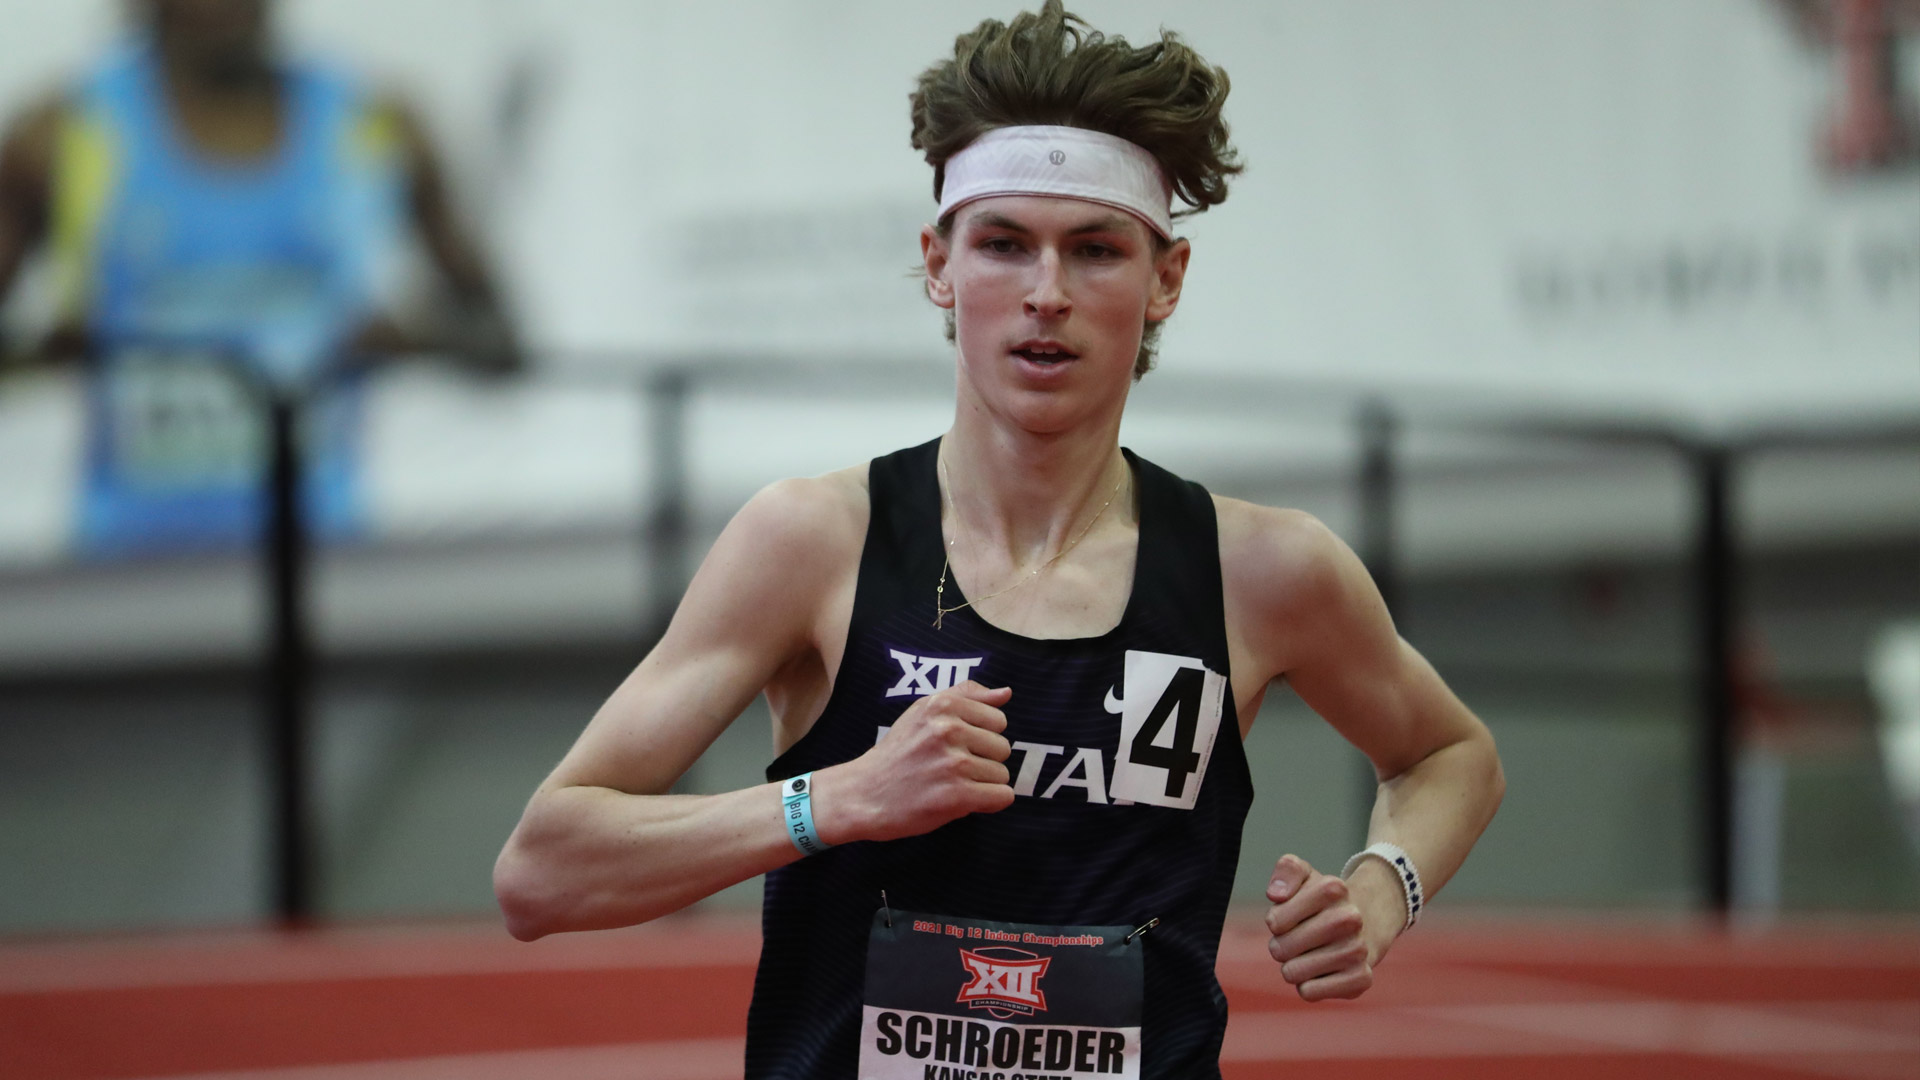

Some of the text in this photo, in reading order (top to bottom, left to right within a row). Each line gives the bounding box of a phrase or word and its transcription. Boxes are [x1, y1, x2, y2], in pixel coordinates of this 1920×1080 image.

[885, 648, 983, 698] XII
[1128, 666, 1206, 799] 4
[790, 802, 802, 819] BIG
[793, 821, 805, 835] 12
[913, 920, 1104, 947] 2021 Big 12 Indoor Championships
[965, 958, 1040, 1004] XII
[876, 1012, 1126, 1074] SCHROEDER
